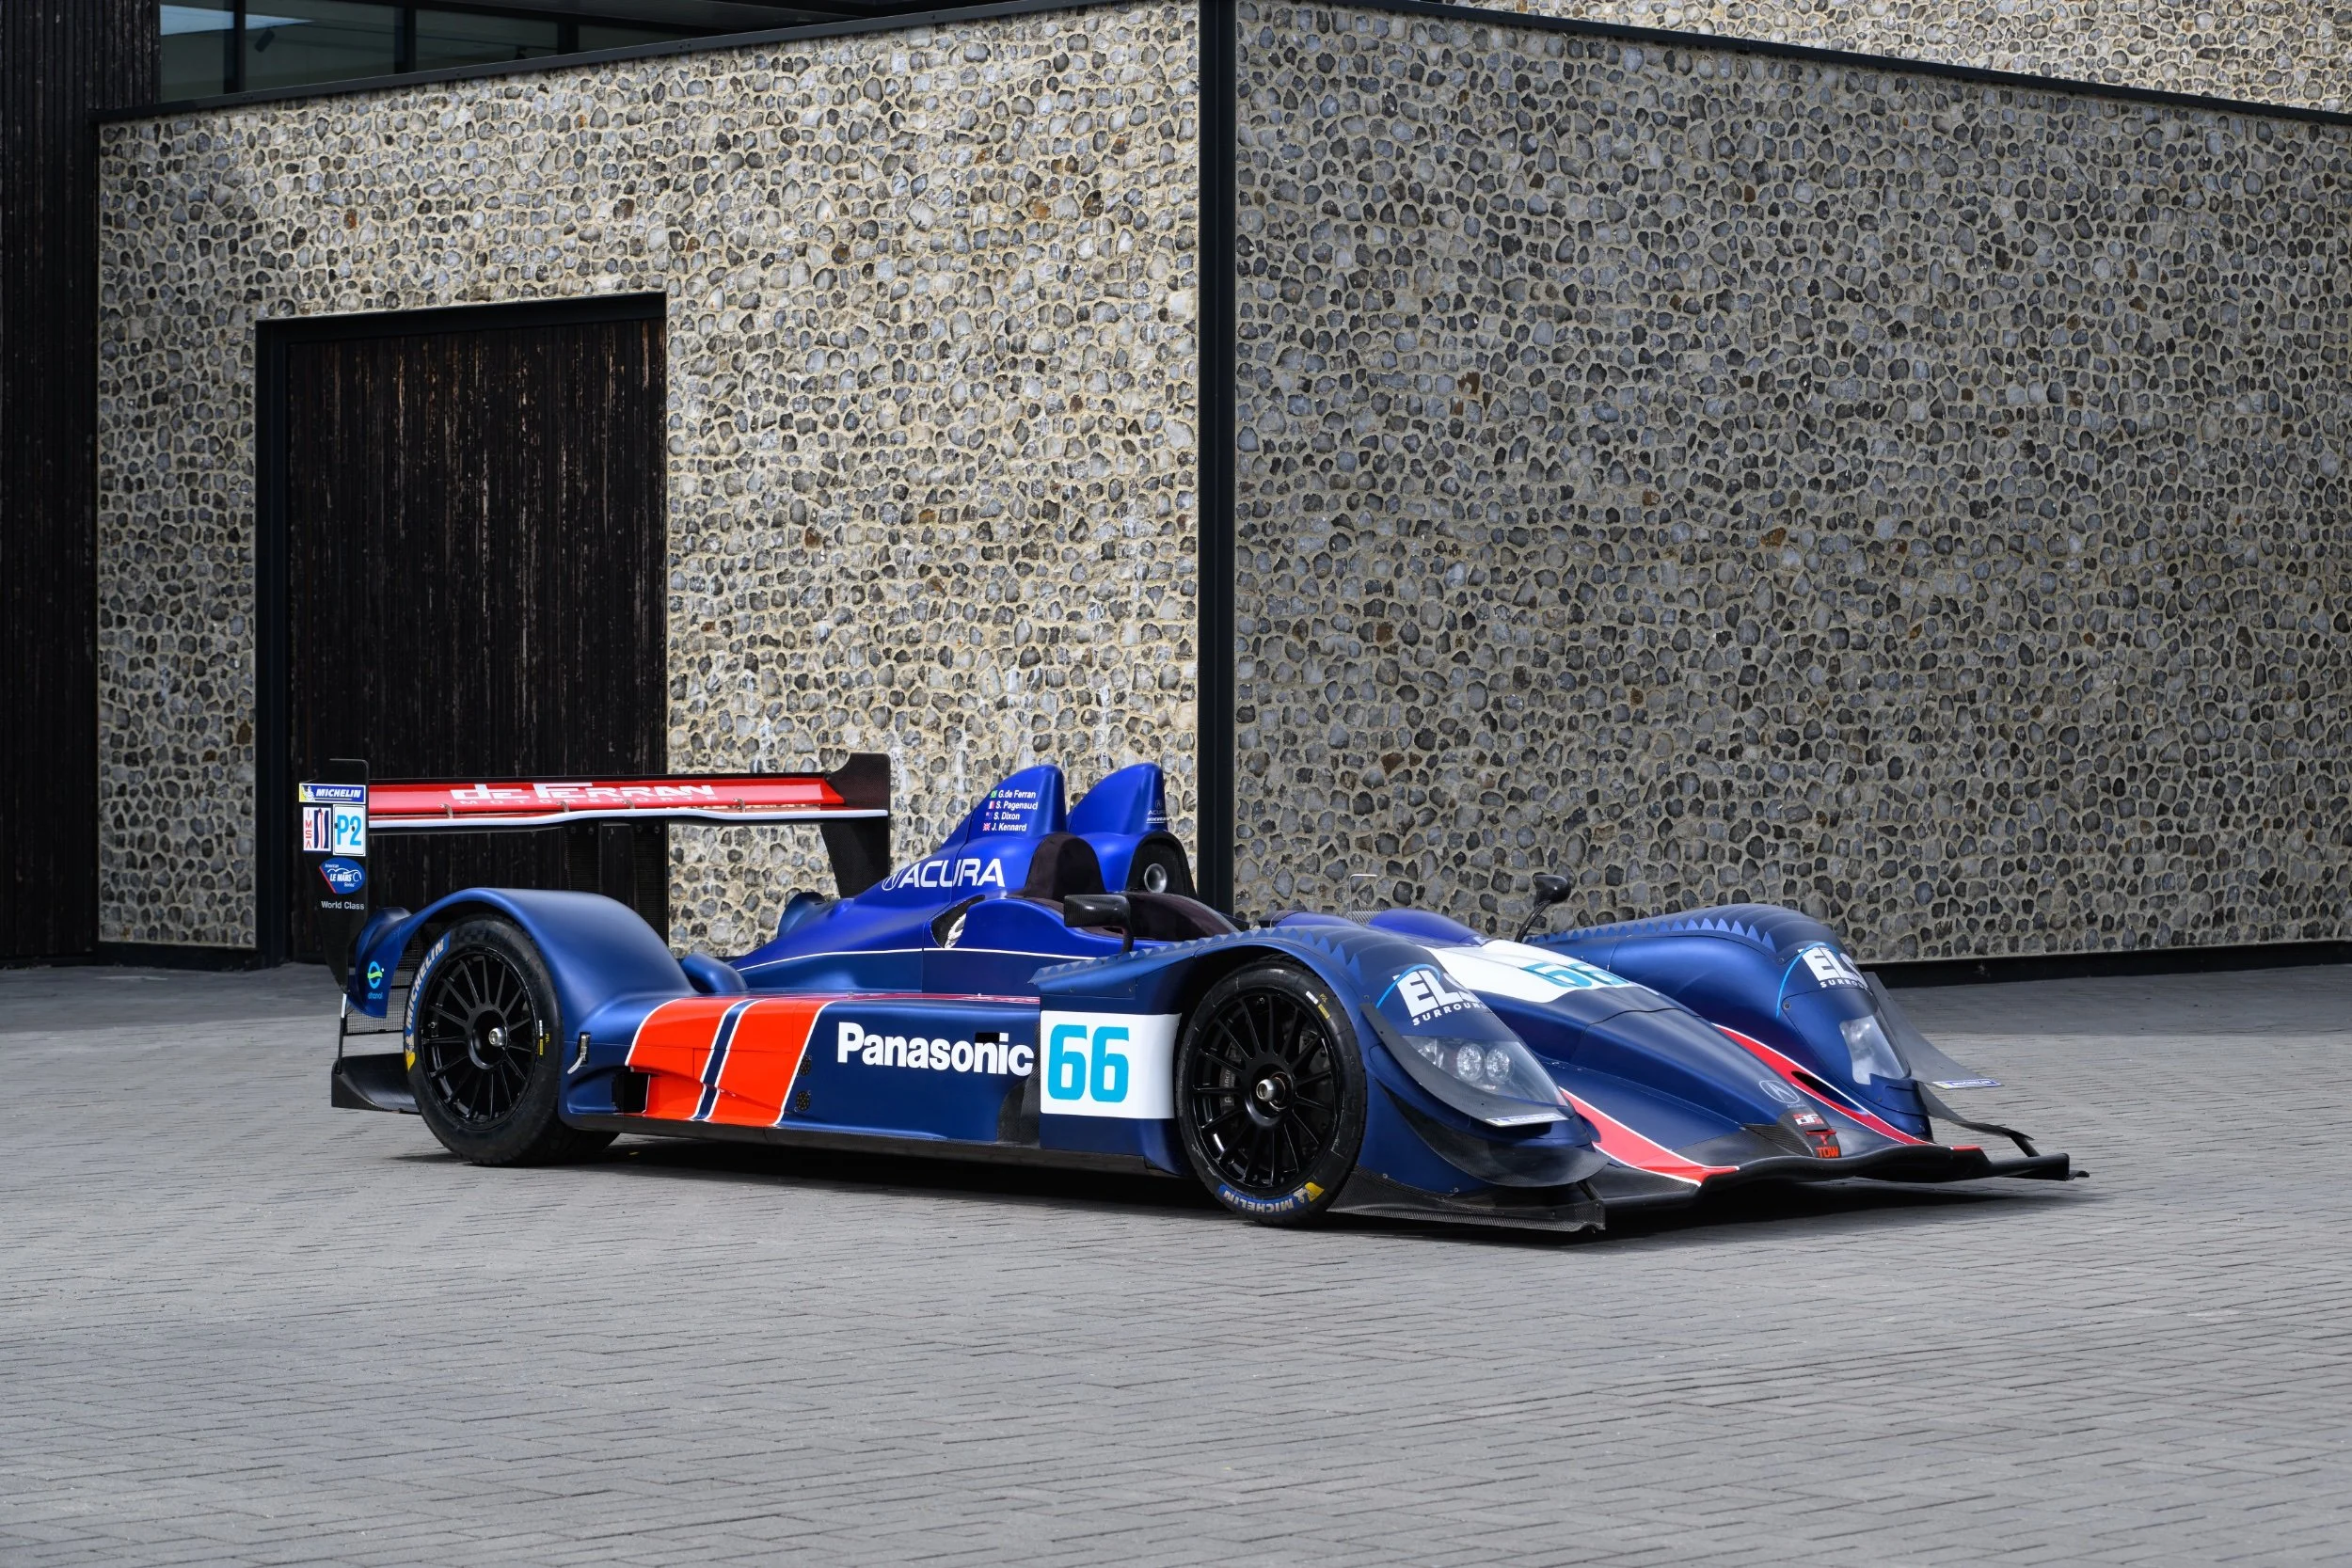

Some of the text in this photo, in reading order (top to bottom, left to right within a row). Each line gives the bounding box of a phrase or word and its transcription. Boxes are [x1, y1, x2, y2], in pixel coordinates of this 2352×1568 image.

[316, 788, 361, 798] MICHELIN
[533, 782, 715, 800] FERRAN
[1014, 790, 1037, 799] Ferran
[996, 800, 1039, 811] S. Pagenaud
[993, 812, 1021, 820] S. Dixon
[337, 815, 362, 846] P2
[998, 823, 1027, 832] Kennard
[330, 873, 353, 882] LE MANS
[898, 858, 1006, 888] ACURA
[321, 901, 342, 910] World
[405, 939, 444, 1030] MICHELIN
[837, 1022, 1033, 1077] Panasonic
[1048, 1024, 1129, 1102] 66
[1816, 1146, 1839, 1158] TOW
[1224, 1190, 1294, 1213] MICHELIN
